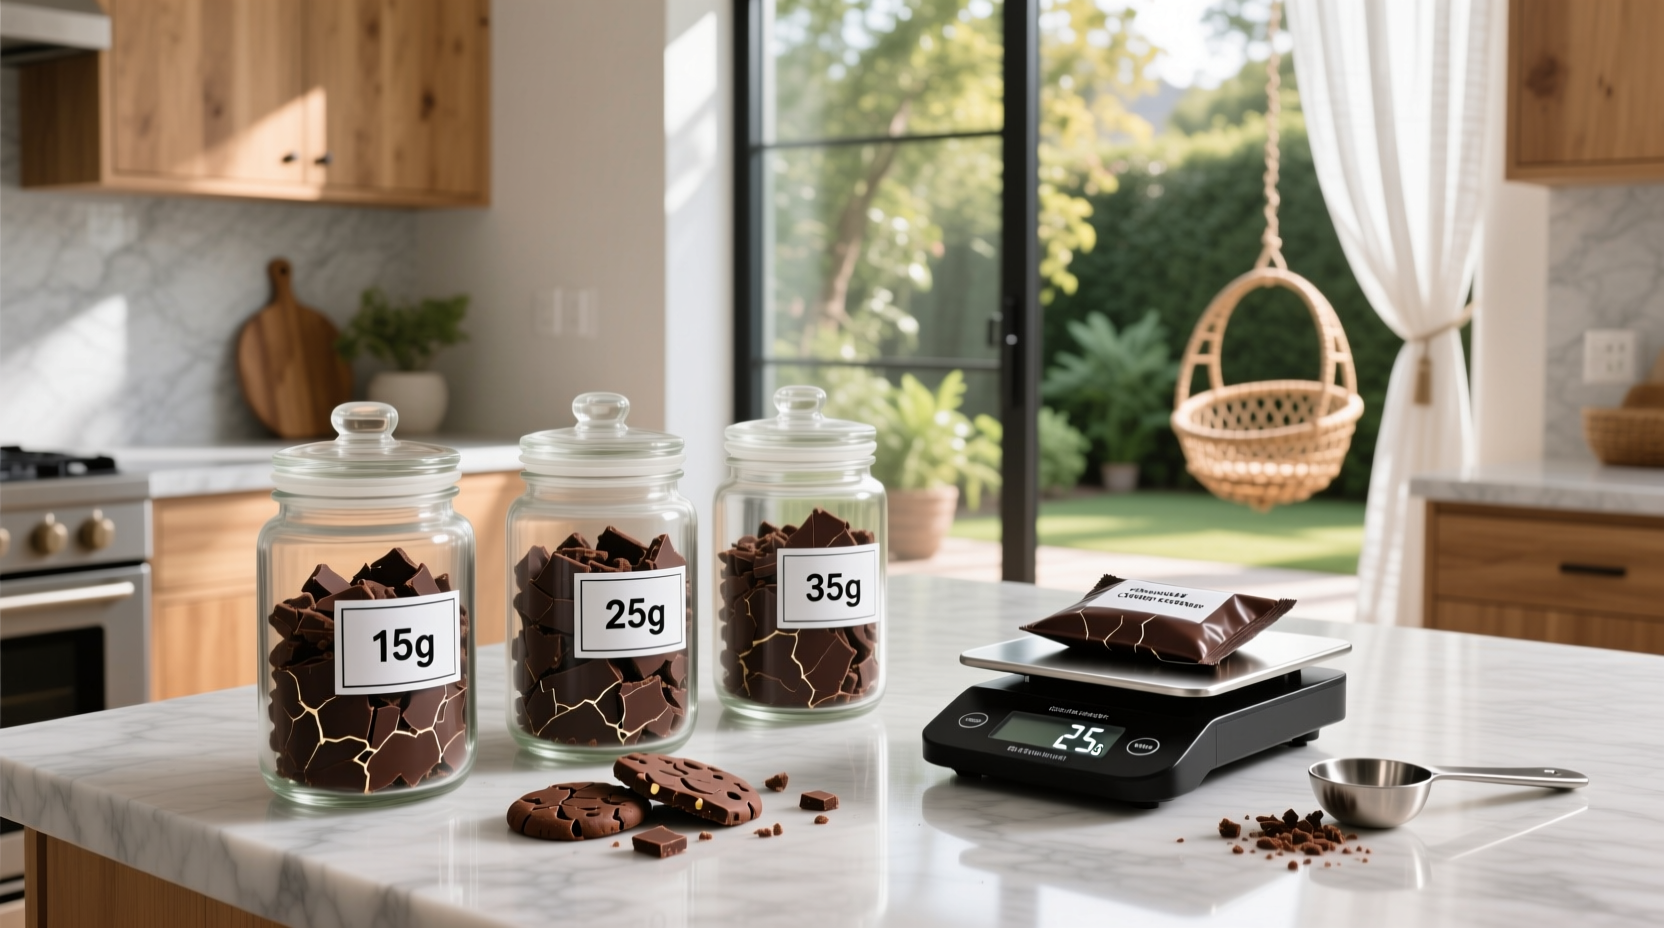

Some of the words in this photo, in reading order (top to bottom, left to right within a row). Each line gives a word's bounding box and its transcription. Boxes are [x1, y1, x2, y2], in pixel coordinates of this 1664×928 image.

[806, 572, 861, 608] 35g
[605, 597, 665, 636] 25g
[372, 627, 434, 668] 15g
